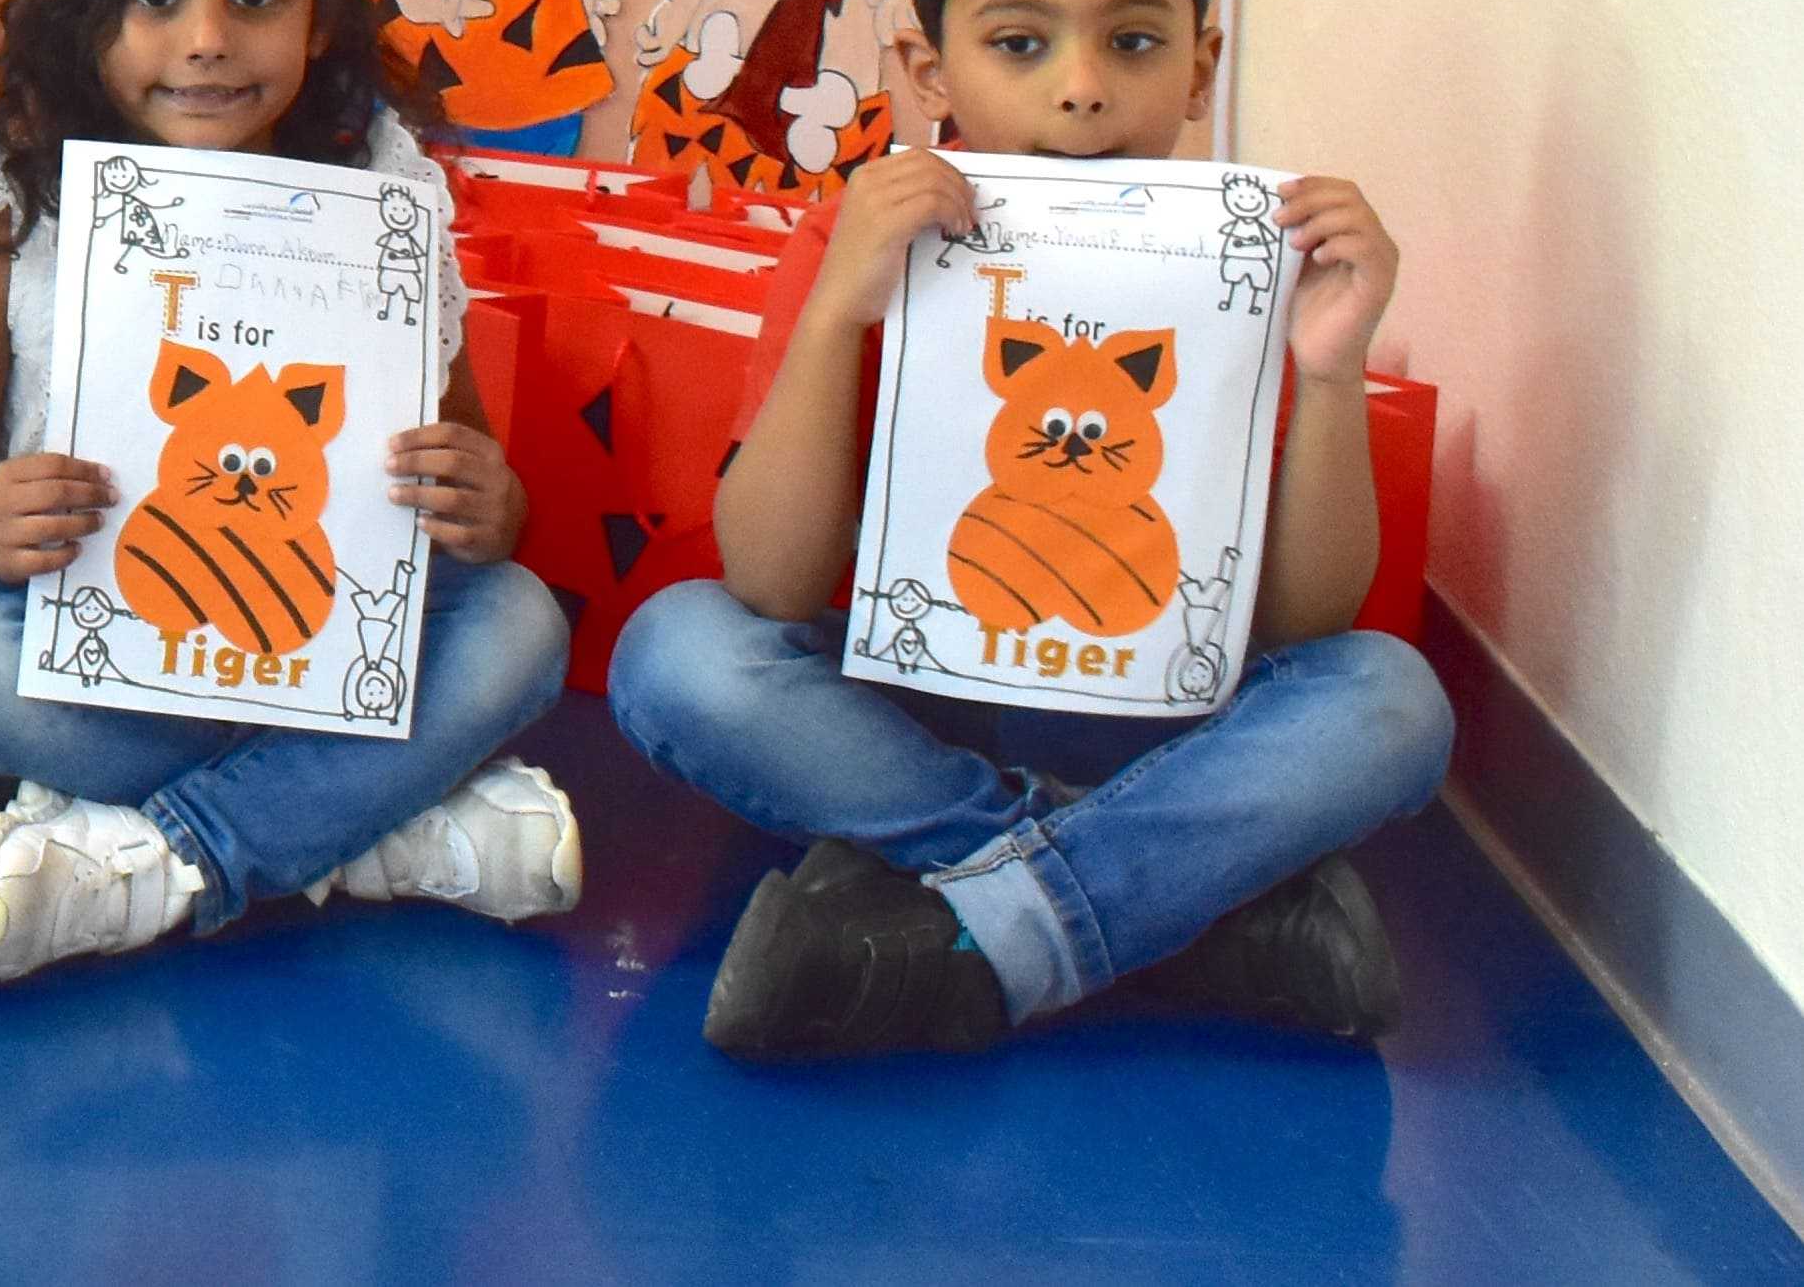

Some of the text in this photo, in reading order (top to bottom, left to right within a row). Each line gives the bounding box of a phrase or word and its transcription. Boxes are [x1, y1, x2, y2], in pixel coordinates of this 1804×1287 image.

[149, 270, 275, 348] T is for
[974, 263, 1027, 317] T
[1064, 313, 1105, 340] for
[157, 628, 312, 689] Tiger
[978, 625, 1136, 678] Tiger
